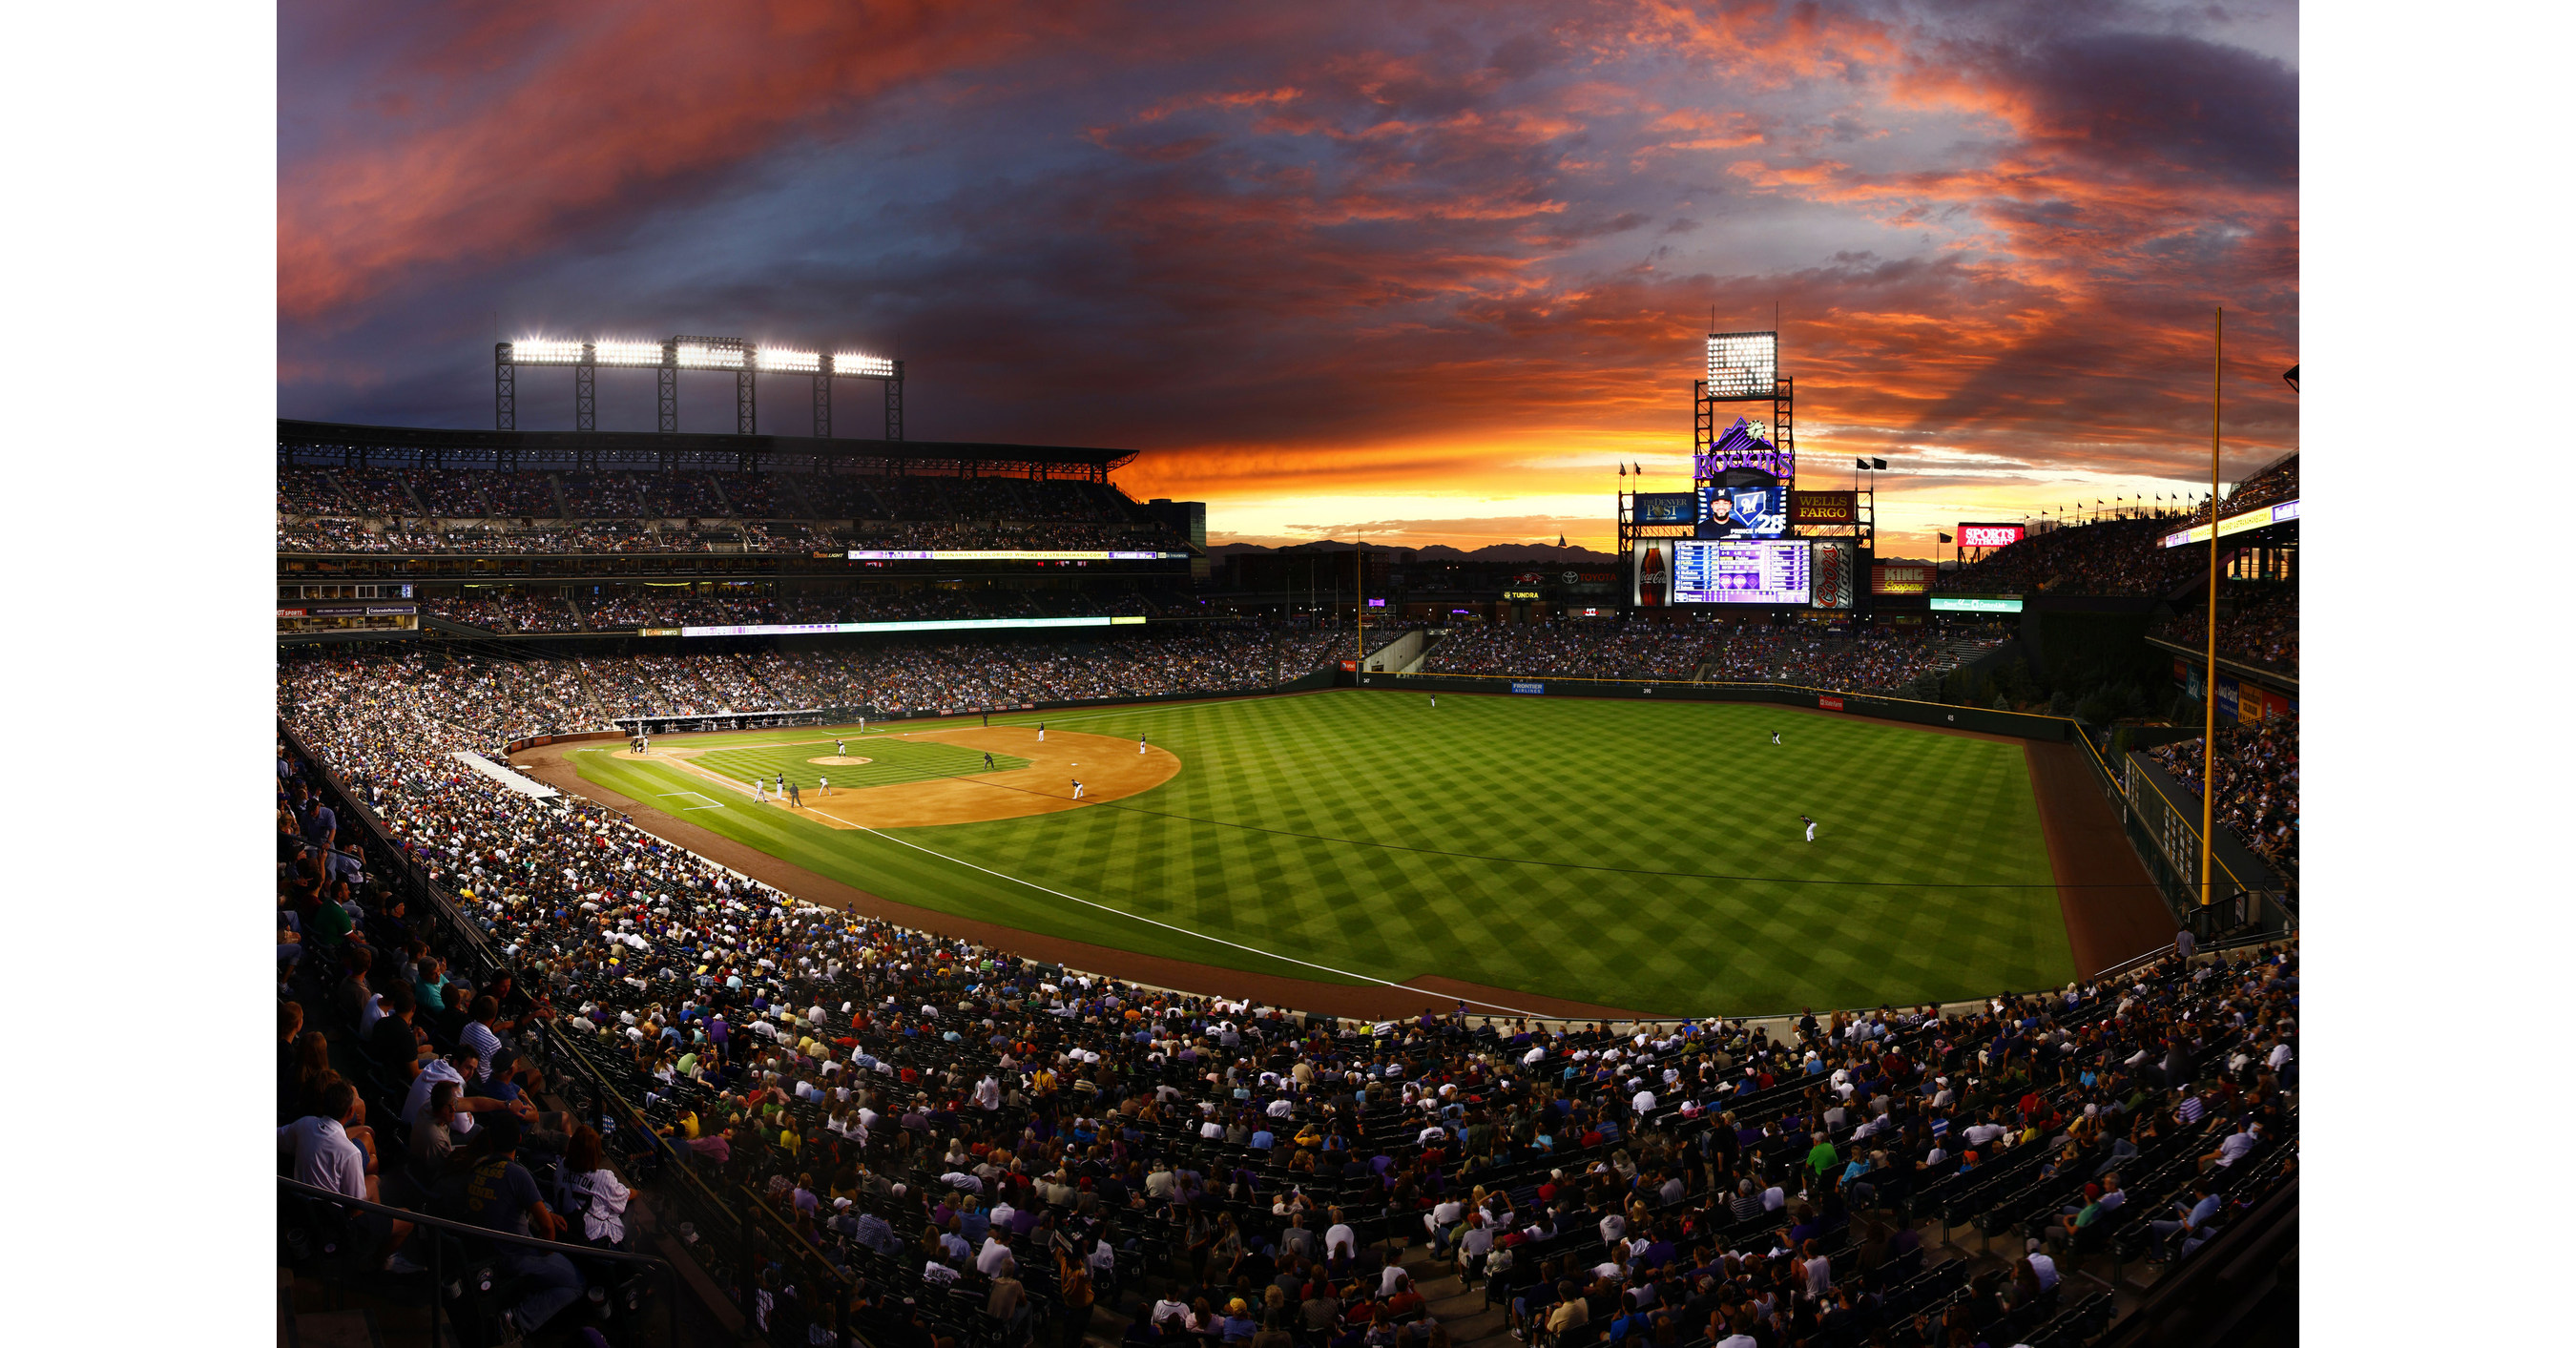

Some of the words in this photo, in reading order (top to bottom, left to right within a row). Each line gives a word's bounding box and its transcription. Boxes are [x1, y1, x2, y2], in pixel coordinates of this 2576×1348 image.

[1692, 452, 1794, 479] ROCKIES
[1798, 496, 1847, 507] WELLS
[1799, 508, 1847, 518] FARGO
[1965, 528, 2015, 539] SPORTS
[1580, 572, 1617, 581] TOYOTA
[1816, 544, 1839, 608] Coors
[1839, 548, 1851, 608] LIGHT
[1884, 569, 1924, 580] KING
[1883, 580, 1924, 593] Soopers
[562, 1173, 594, 1191] HELTON
